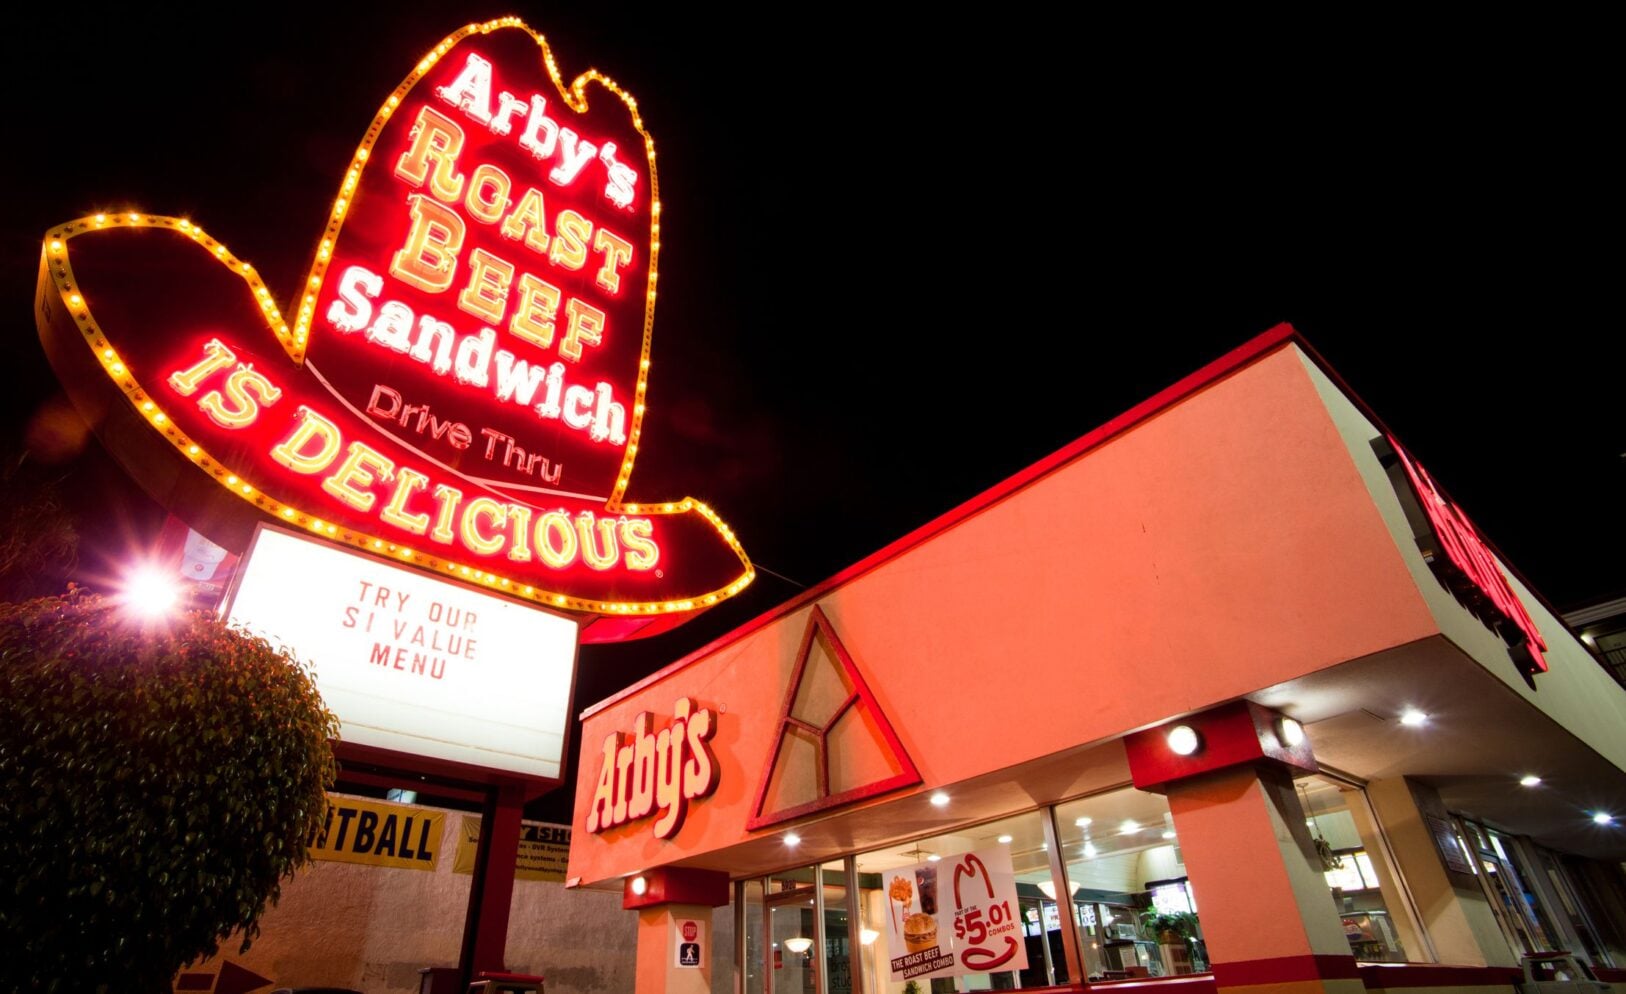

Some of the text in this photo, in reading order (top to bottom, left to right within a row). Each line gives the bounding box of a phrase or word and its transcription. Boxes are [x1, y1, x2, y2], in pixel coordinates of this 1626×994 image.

[436, 53, 638, 208] Arby's
[394, 105, 633, 294] ROAST
[389, 194, 606, 363] BEEF
[327, 265, 626, 446] Sandwich
[167, 338, 660, 571] IS DELICIOUS
[366, 384, 562, 485] Drive Thru
[360, 580, 478, 632] TRY OUR
[393, 619, 477, 660] VALUE
[369, 642, 446, 680] MENU
[586, 697, 715, 839] Arby's
[892, 948, 939, 970] THE ROAST BEEF
[954, 901, 1012, 945] $5.01
[988, 923, 1015, 936] COMBOS
[904, 956, 954, 978] SANDWICH COMBO
